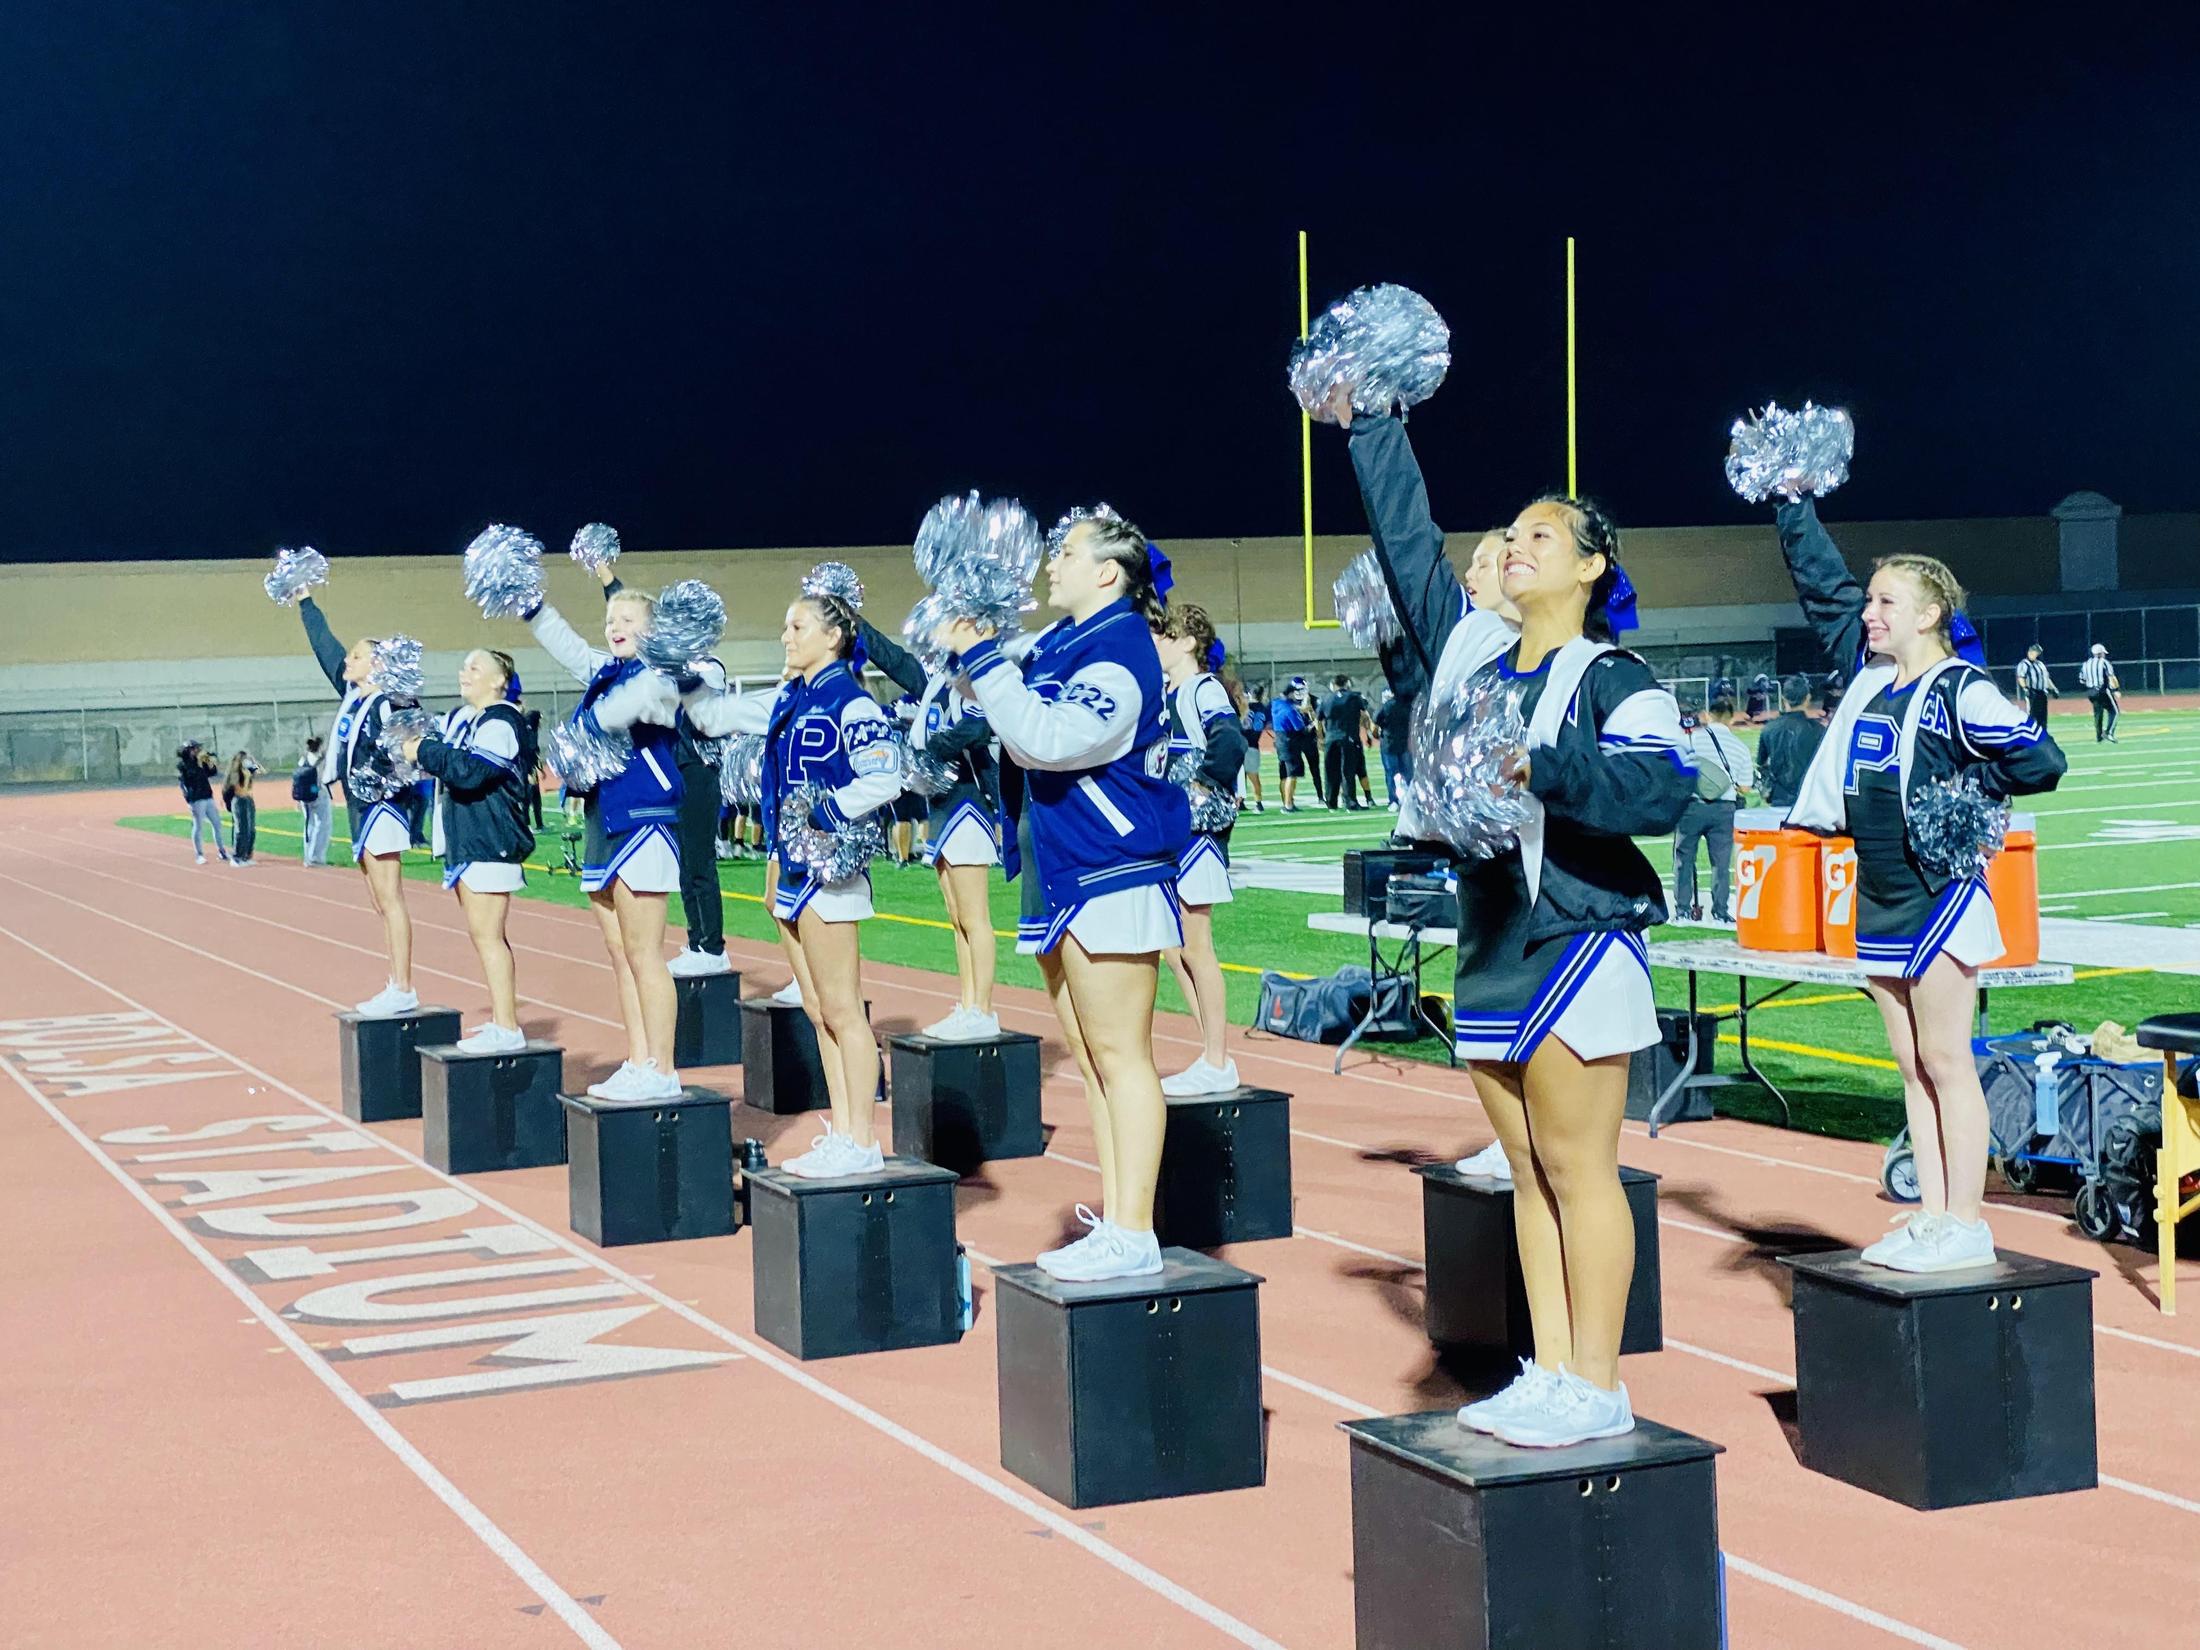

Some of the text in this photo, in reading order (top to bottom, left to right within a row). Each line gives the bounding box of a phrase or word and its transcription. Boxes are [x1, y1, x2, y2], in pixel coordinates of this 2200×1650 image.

[786, 714, 841, 785] P
[1844, 713, 1901, 796] P
[0, 1011, 747, 1400] BOLSA STADIUM
